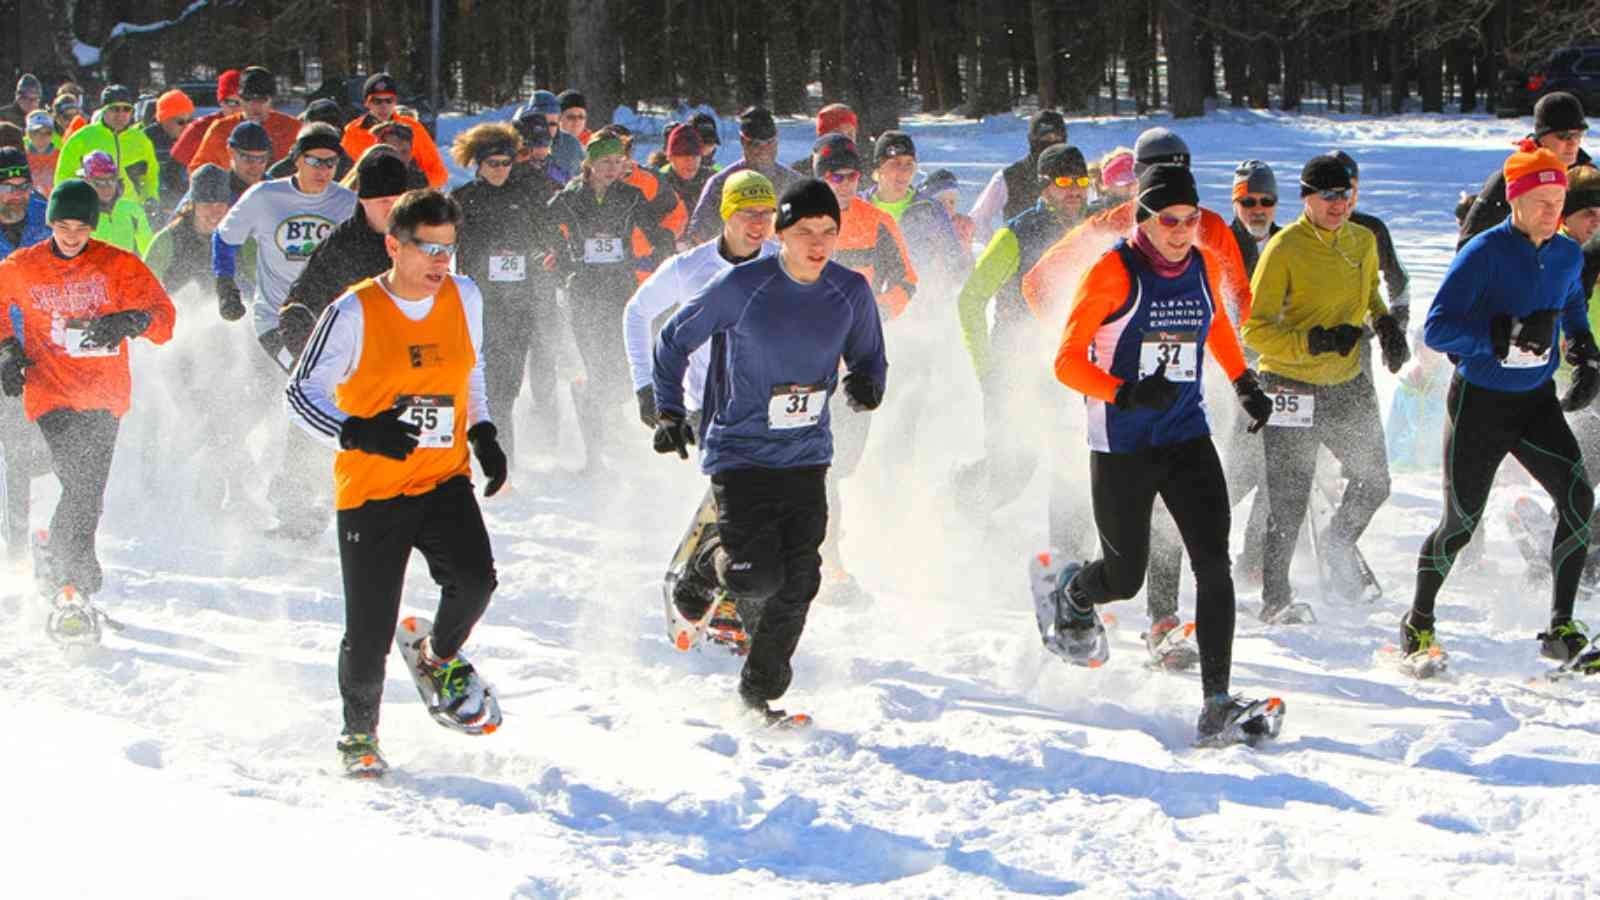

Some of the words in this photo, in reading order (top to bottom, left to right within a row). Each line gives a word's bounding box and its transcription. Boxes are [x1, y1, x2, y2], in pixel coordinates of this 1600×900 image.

[287, 221, 331, 240] BTC
[595, 239, 614, 253] 35
[501, 256, 519, 271] 26
[1150, 310, 1203, 318] RUNNING
[1150, 319, 1203, 327] EXCHANGE
[1157, 343, 1181, 365] 37
[786, 394, 809, 413] 31
[1274, 394, 1299, 412] 95
[410, 407, 438, 430] 55
